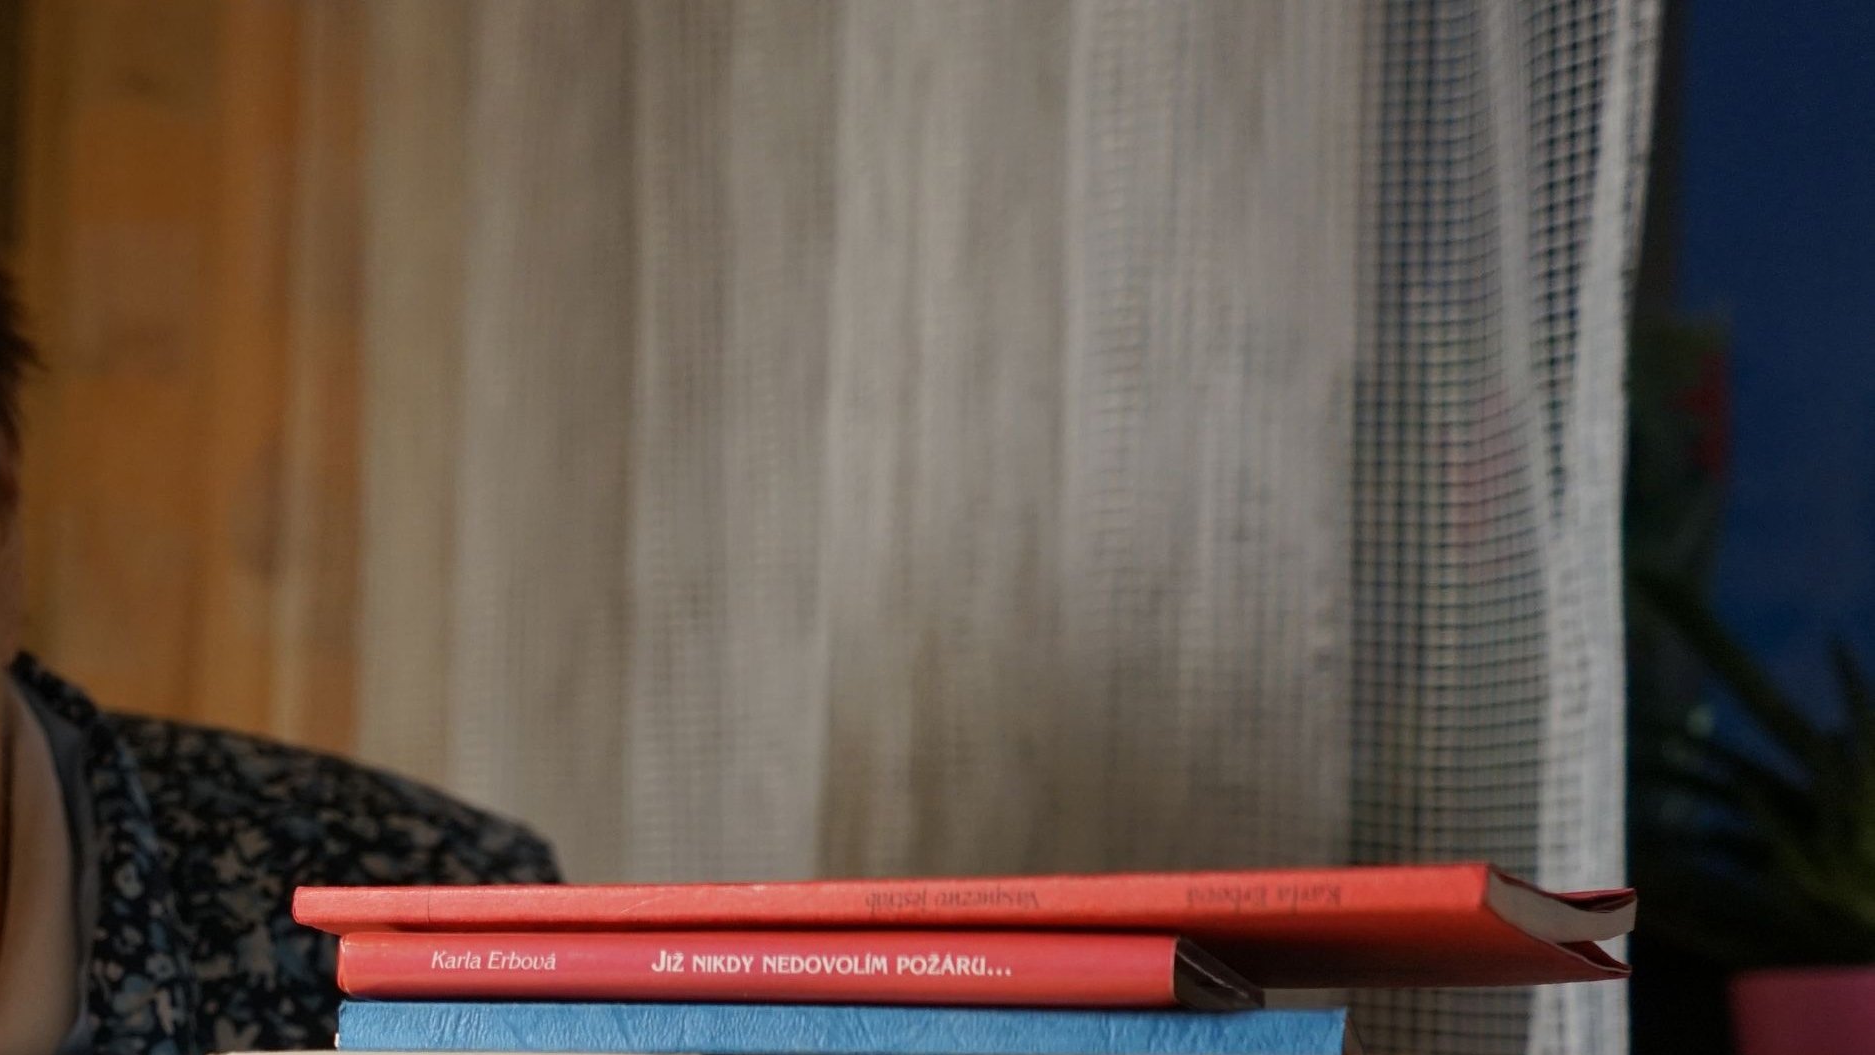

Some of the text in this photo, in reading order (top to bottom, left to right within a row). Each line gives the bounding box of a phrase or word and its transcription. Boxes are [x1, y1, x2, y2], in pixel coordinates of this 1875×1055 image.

[431, 950, 556, 971] Karla Erbová
[692, 954, 753, 973] NIKDY
[762, 953, 888, 975] NEDOVOLÍM
